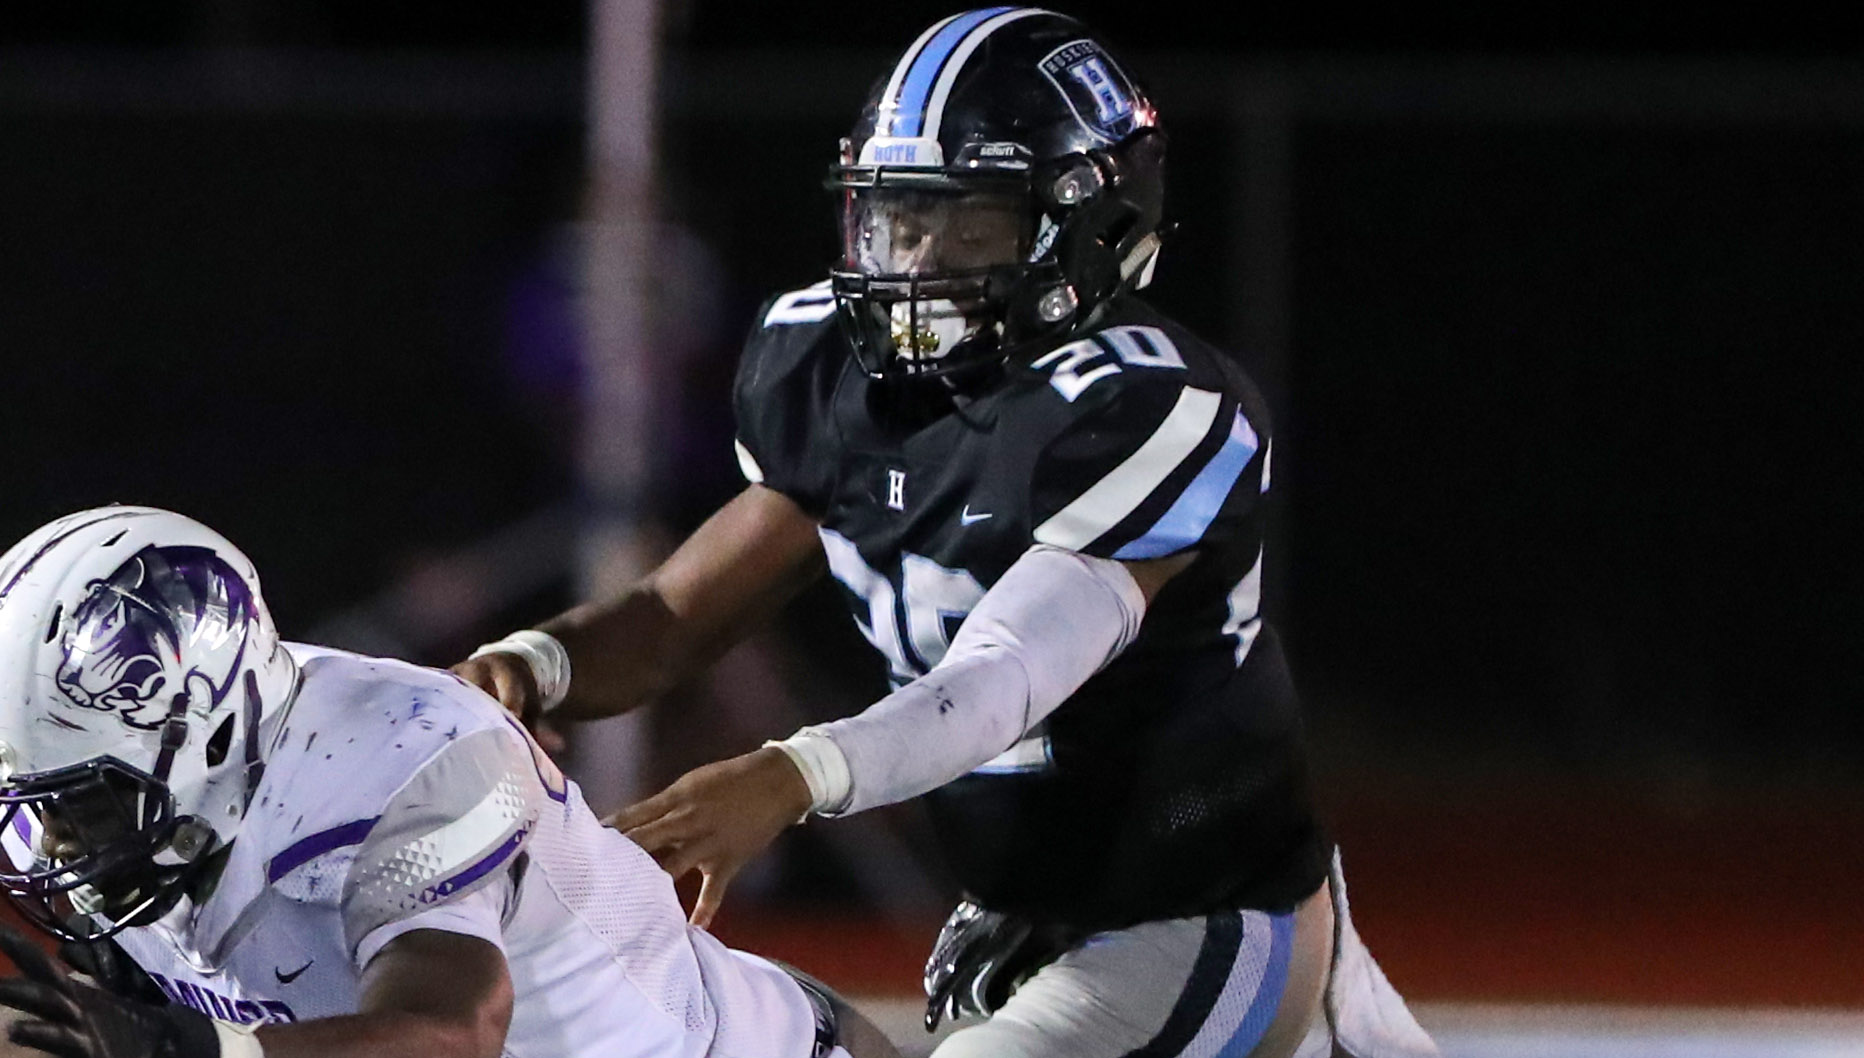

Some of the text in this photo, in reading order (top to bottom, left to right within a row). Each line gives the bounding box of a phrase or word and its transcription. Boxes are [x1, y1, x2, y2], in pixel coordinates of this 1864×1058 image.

[1045, 42, 1097, 74] HUSKIE
[874, 145, 918, 163] HOTH
[1030, 325, 1188, 403] 20
[888, 470, 906, 511] H
